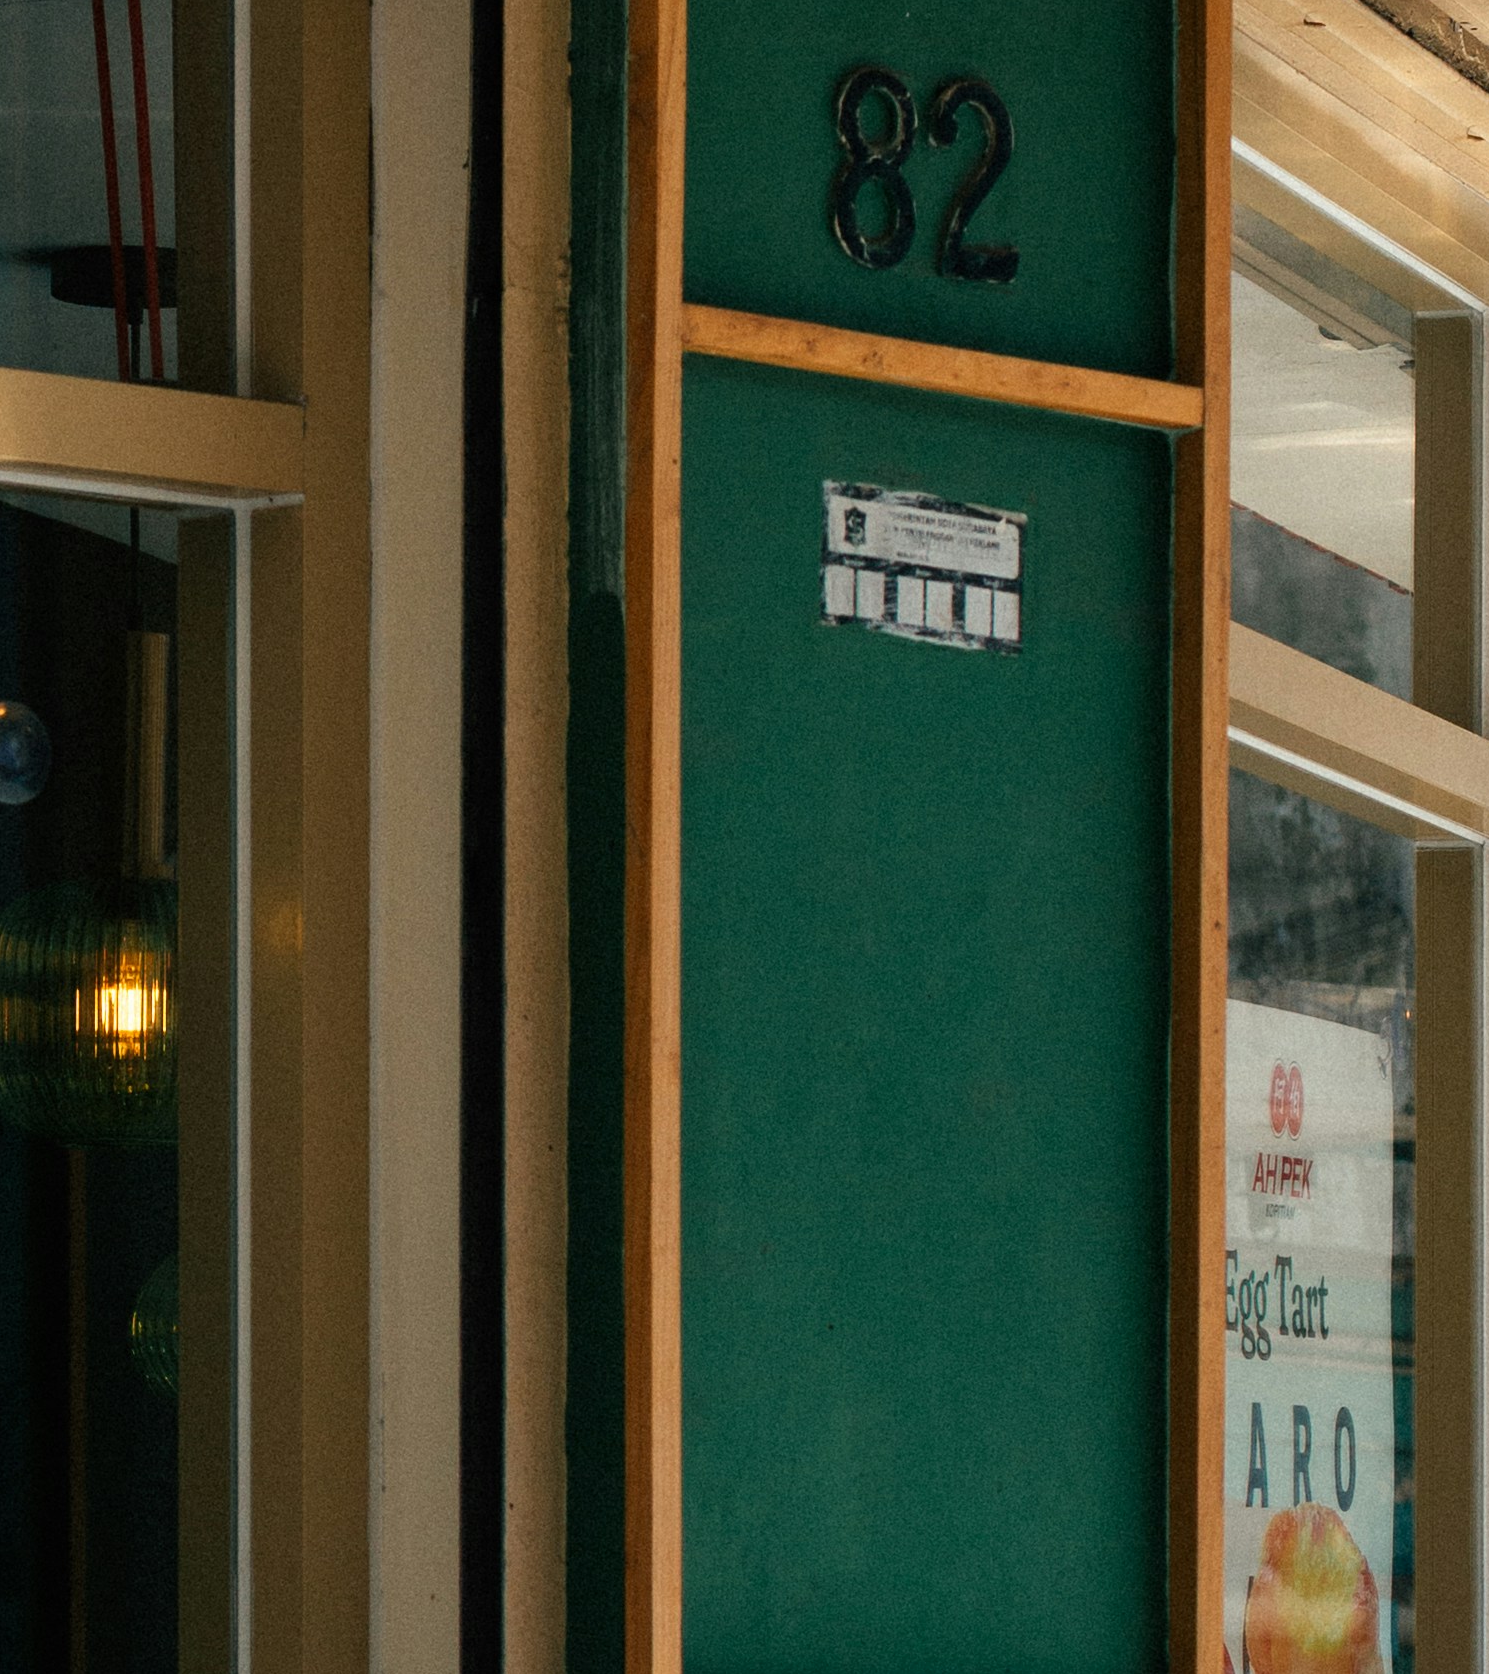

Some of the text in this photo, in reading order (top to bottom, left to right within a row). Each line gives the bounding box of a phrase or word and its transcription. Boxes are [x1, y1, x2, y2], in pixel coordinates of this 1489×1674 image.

[833, 66, 1020, 284] 82
[1252, 1151, 1314, 1200] AH PEK
[1225, 1249, 1330, 1362] Egg Tart
[1245, 1402, 1356, 1513] ARO
